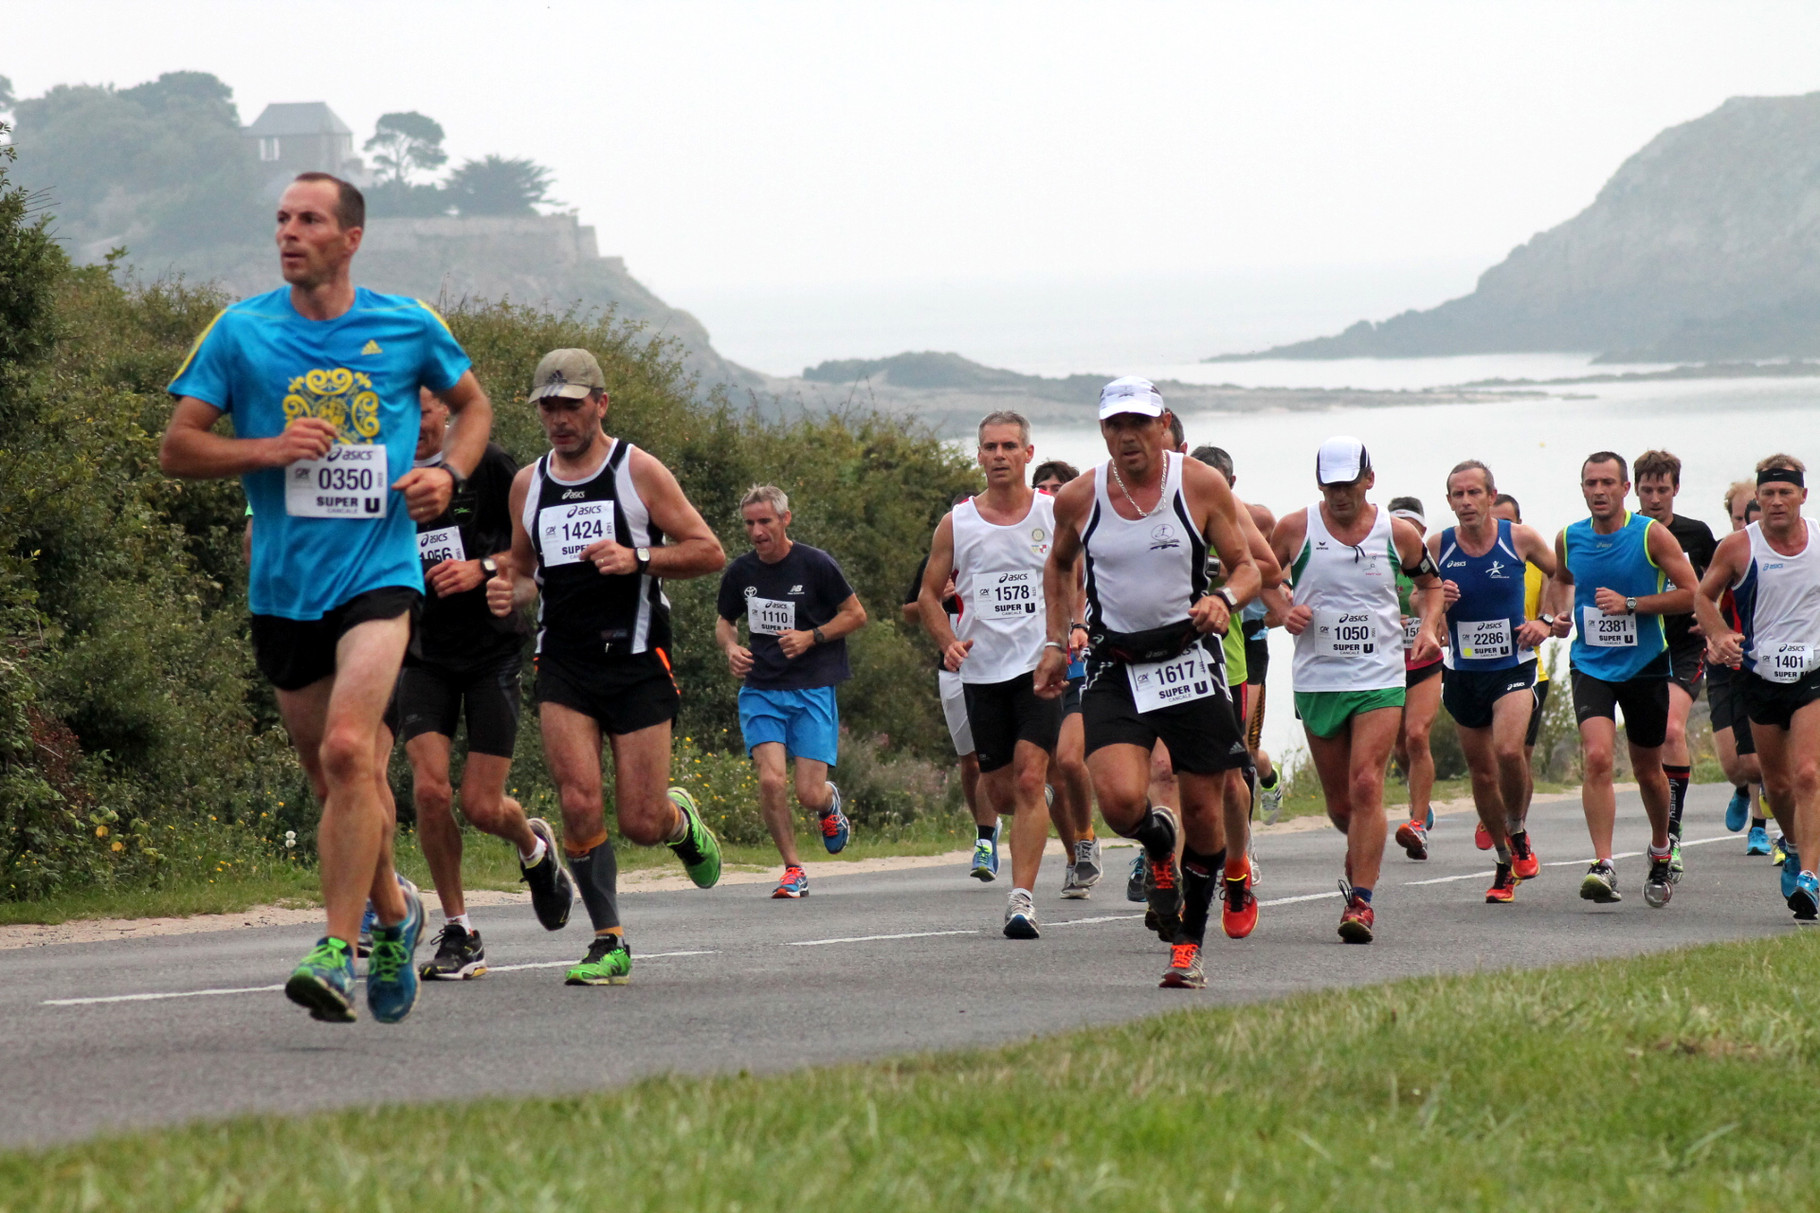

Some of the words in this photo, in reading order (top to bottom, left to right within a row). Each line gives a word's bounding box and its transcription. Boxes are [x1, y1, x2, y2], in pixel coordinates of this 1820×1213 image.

[343, 450, 373, 460] asics
[319, 468, 372, 490] 0350
[570, 491, 585, 499] asics
[317, 496, 358, 507] SUPER
[365, 498, 380, 513] U
[578, 506, 602, 515] asics
[562, 520, 603, 540] 1424
[430, 533, 448, 543] asics
[562, 544, 589, 555] SUPE
[1008, 573, 1028, 581] asics
[995, 585, 1029, 601] 1578
[995, 604, 1021, 612] SUPER
[1025, 603, 1035, 613] U
[762, 611, 787, 623] 1110
[1599, 620, 1626, 632] 2381
[1335, 626, 1368, 640] 1050
[1474, 632, 1503, 645] 2286
[1625, 635, 1633, 643] U
[1364, 644, 1373, 653] U
[1500, 646, 1509, 655] U
[1775, 656, 1803, 668] 1401
[1155, 660, 1194, 685] 1617
[1159, 685, 1190, 698] SUPER
[1194, 681, 1208, 694] U
